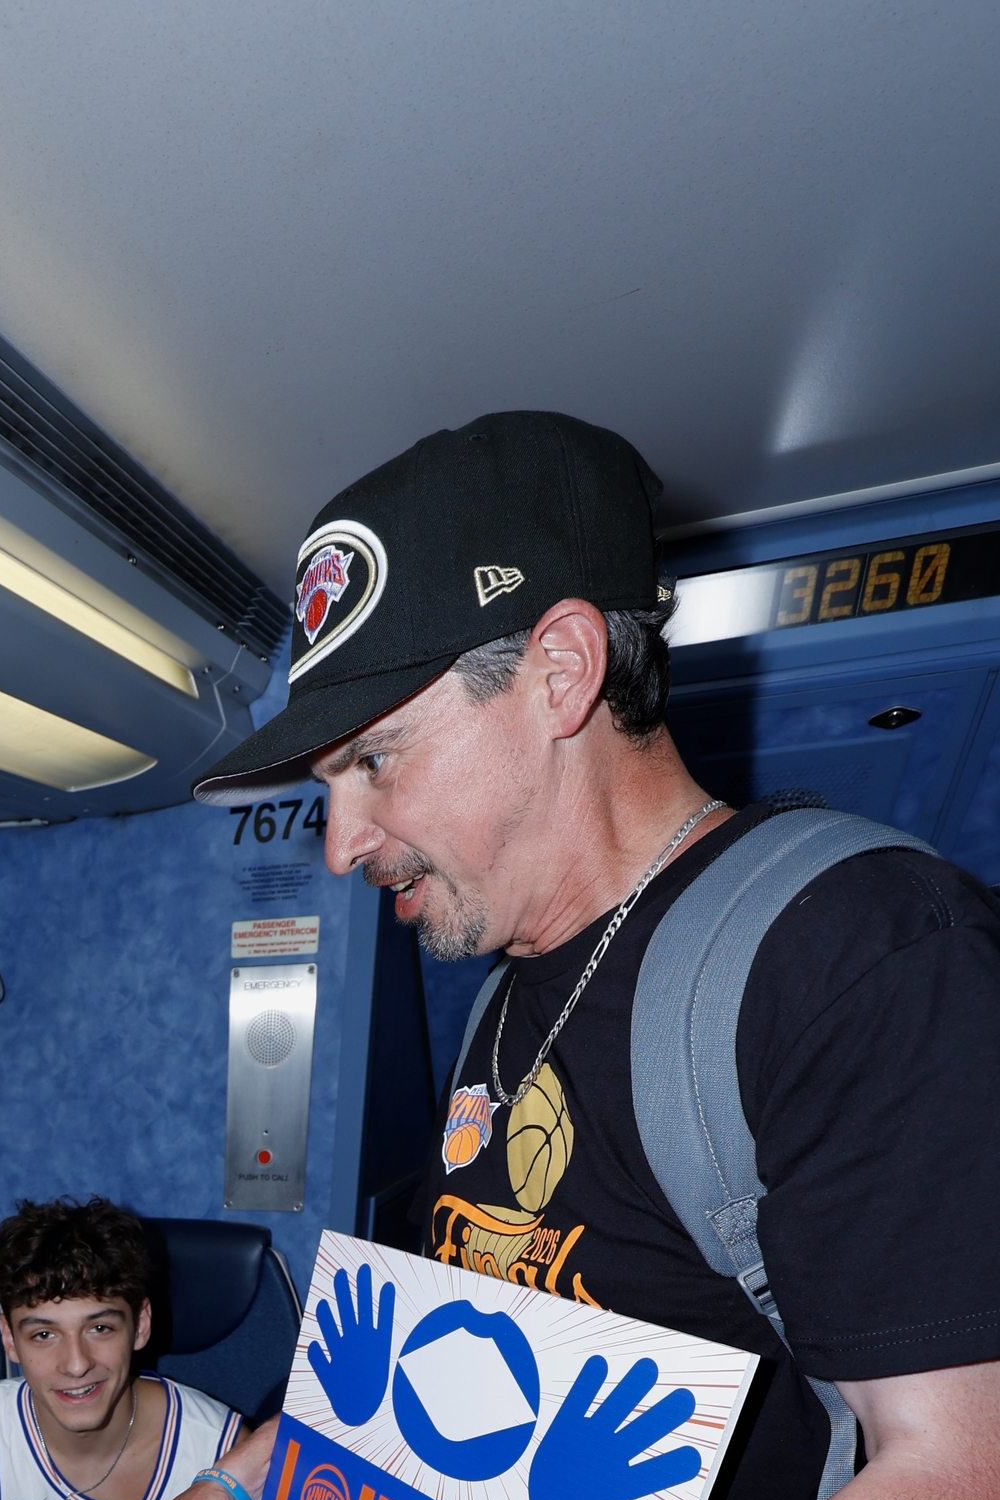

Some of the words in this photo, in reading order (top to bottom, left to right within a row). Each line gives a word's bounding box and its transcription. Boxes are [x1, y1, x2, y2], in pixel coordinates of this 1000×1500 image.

[776, 543, 951, 627] 3260
[229, 796, 327, 845] 7674
[234, 930, 278, 939] EMERGENCY
[279, 927, 317, 936] INTERCOM
[253, 920, 296, 929] PASSENGER
[244, 978, 302, 990] EMERGENCY
[520, 1227, 561, 1265] 2026
